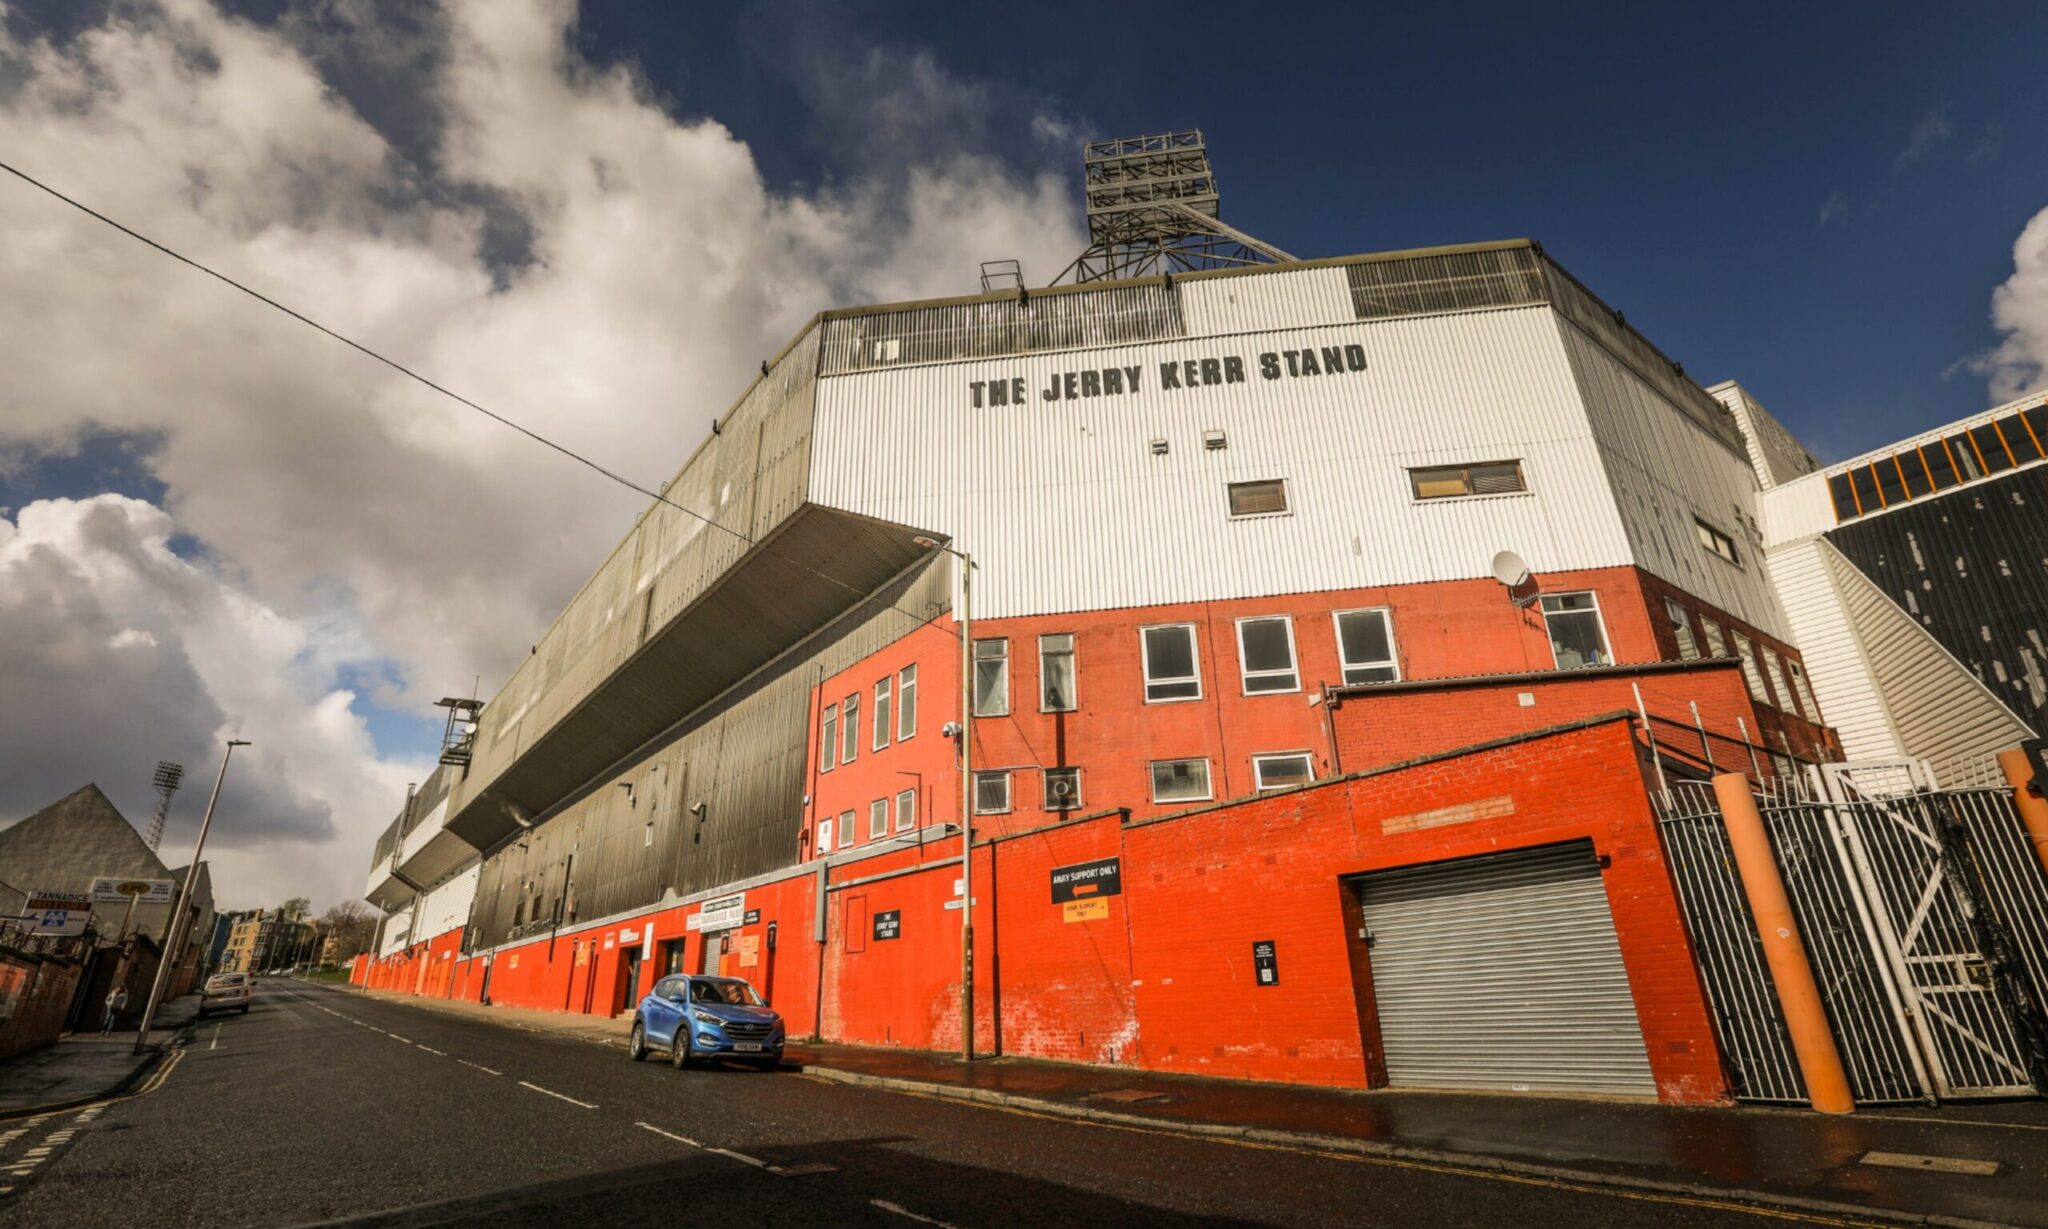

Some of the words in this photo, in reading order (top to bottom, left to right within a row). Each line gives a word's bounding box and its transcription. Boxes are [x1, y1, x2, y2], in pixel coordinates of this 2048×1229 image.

[969, 376, 1026, 409] THE
[1043, 364, 1141, 401] JERRY
[1160, 355, 1245, 391] KERR
[1260, 343, 1367, 381] STAND
[1053, 874, 1070, 885] AWAY
[1071, 868, 1099, 881] SUPPORT
[1099, 865, 1117, 876] ONLY
[36, 891, 88, 902] TANNADICE
